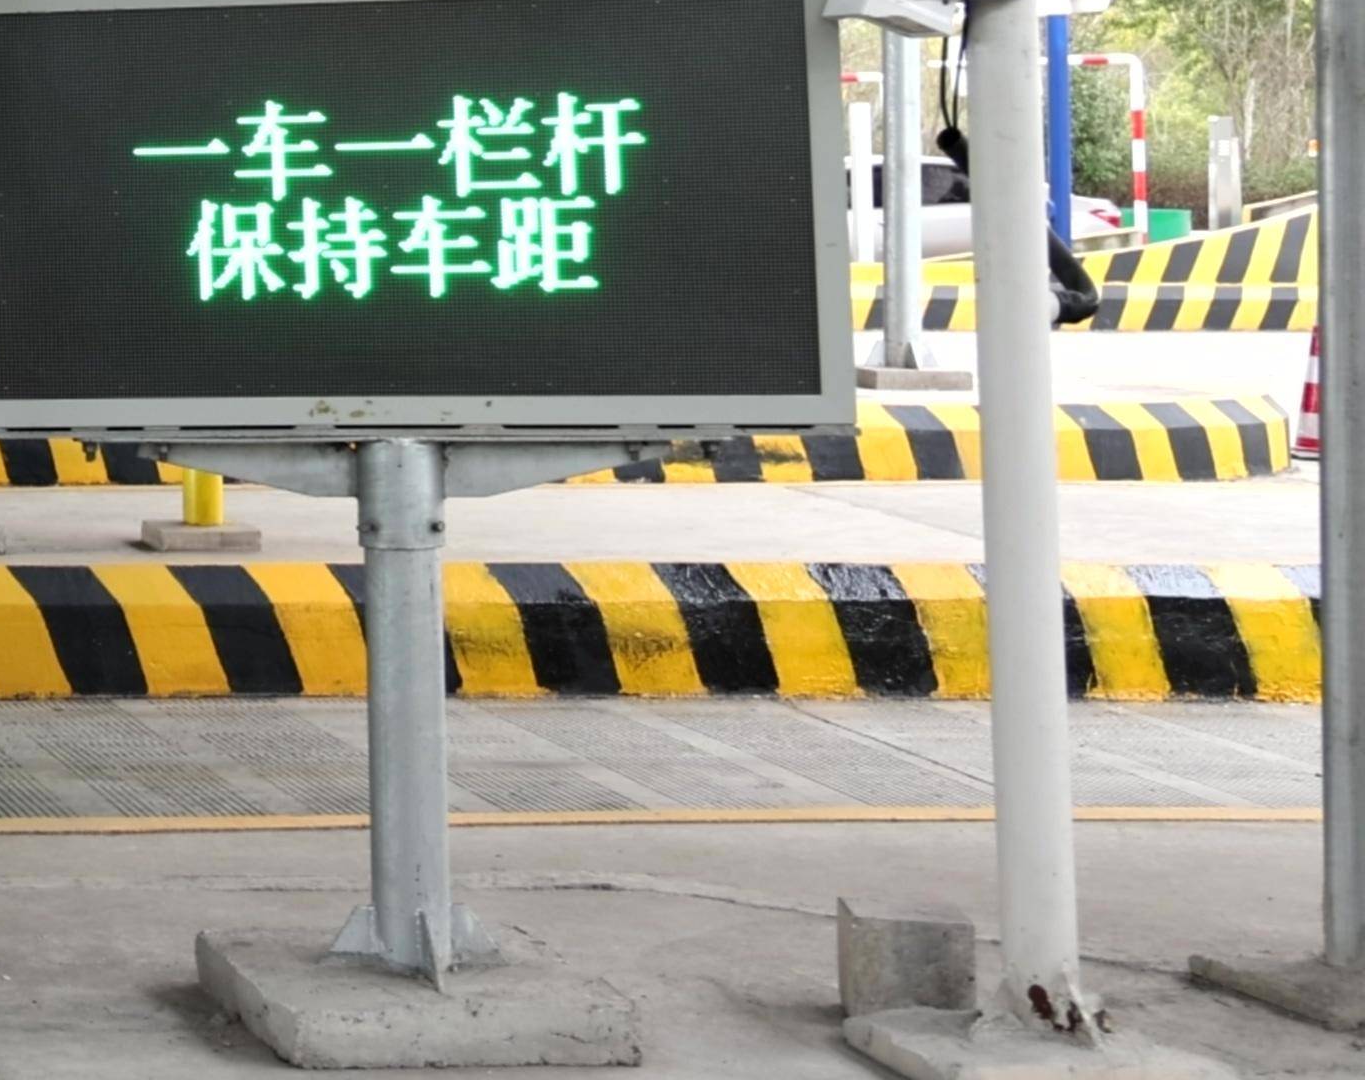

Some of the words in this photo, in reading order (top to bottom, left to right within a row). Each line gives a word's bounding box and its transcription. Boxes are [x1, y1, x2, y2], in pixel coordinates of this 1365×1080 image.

[132, 92, 647, 201] 一车一栏杆
[186, 195, 599, 301] 保持车距
